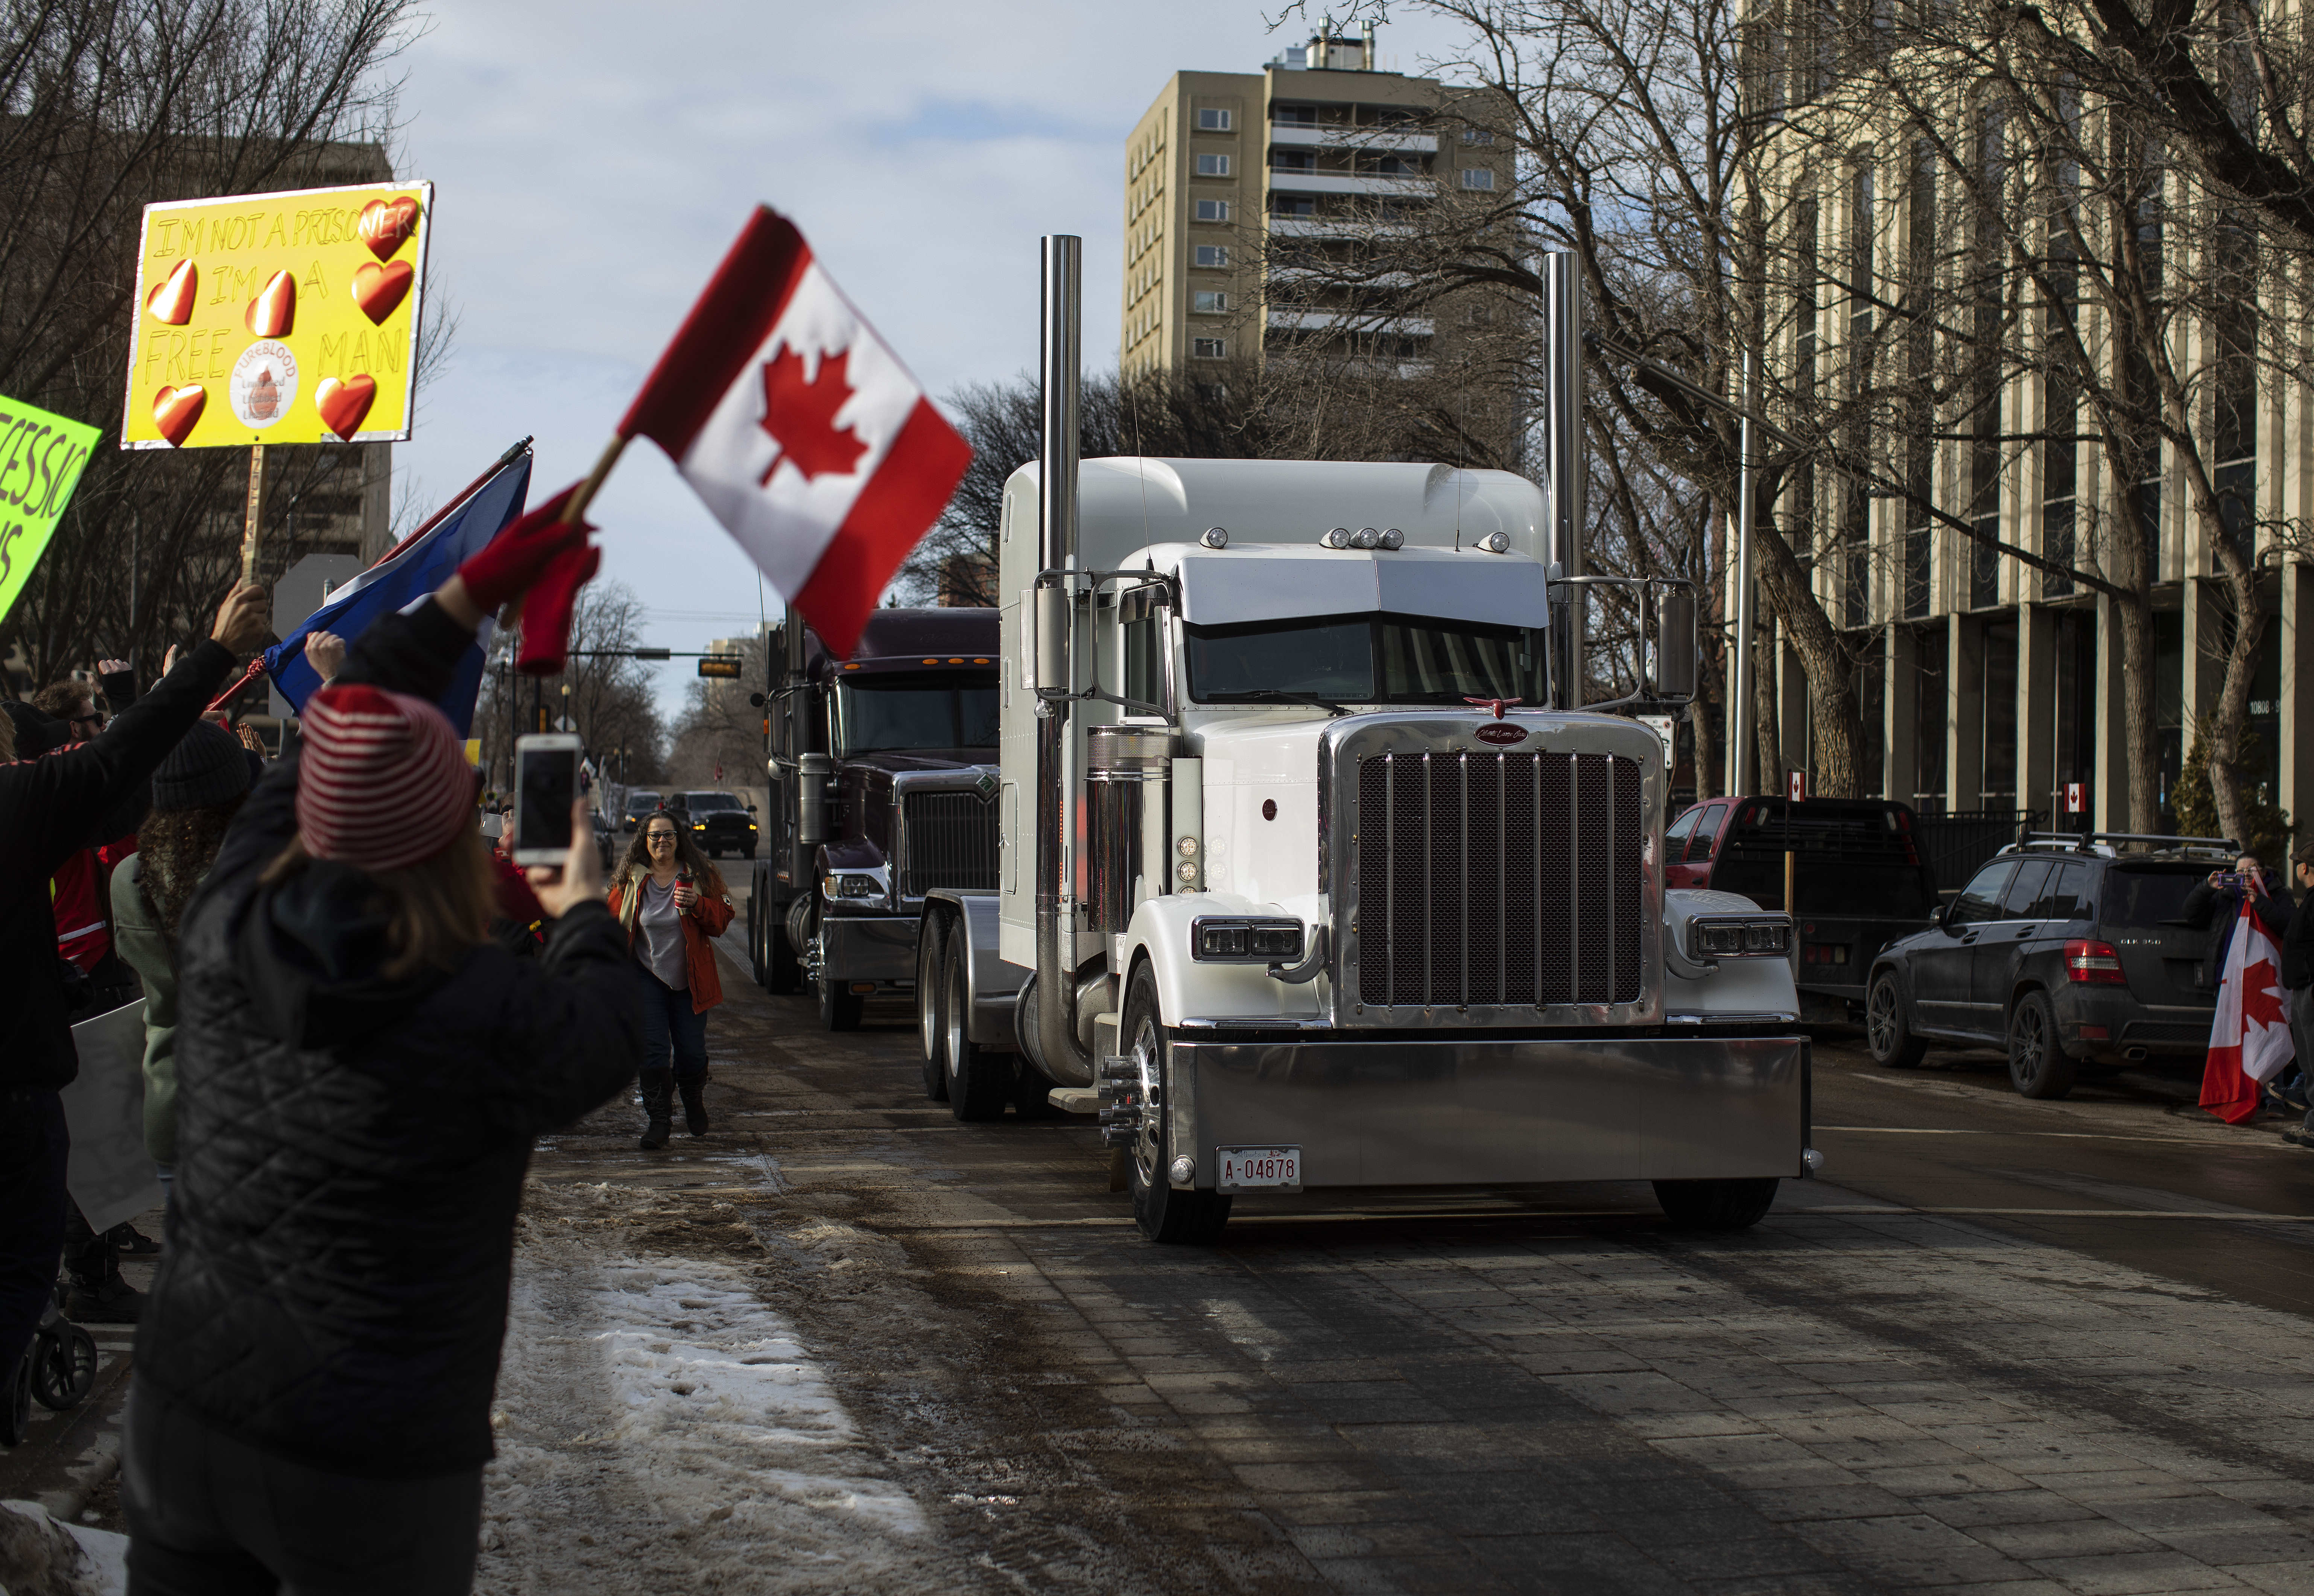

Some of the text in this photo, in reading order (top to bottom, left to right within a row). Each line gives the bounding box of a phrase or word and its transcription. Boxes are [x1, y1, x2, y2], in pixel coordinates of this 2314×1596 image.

[153, 206, 416, 257] I'M NOT A PRISONER
[210, 260, 328, 305] I'M A
[145, 328, 402, 385] FREE MAN
[234, 342, 295, 378] PUREBLOOD
[2250, 700, 2270, 715] 10808
[1477, 729, 1498, 737] Alberta
[1235, 1150, 1262, 1158] Alberta
[1225, 1159, 1294, 1179] A-04878
